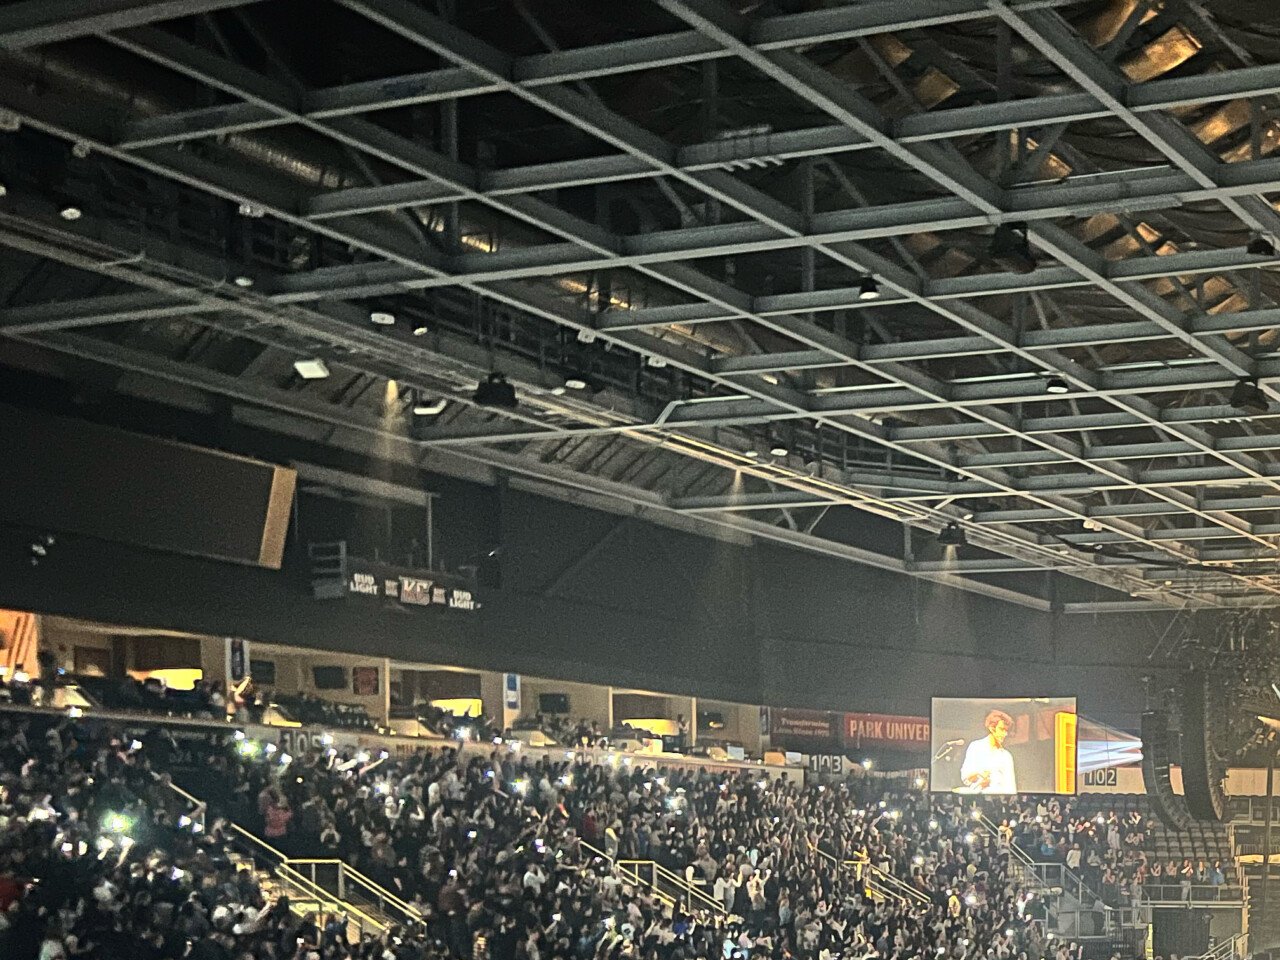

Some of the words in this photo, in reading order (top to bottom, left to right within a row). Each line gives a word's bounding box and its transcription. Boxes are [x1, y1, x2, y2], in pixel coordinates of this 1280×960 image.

[354, 574, 374, 584] BUD
[350, 581, 377, 595] LIGHT
[453, 590, 471, 600] BUD
[449, 598, 474, 609] LIGHT
[850, 720, 883, 738] PARK
[811, 755, 842, 771] 103
[1088, 769, 1116, 784] 102
